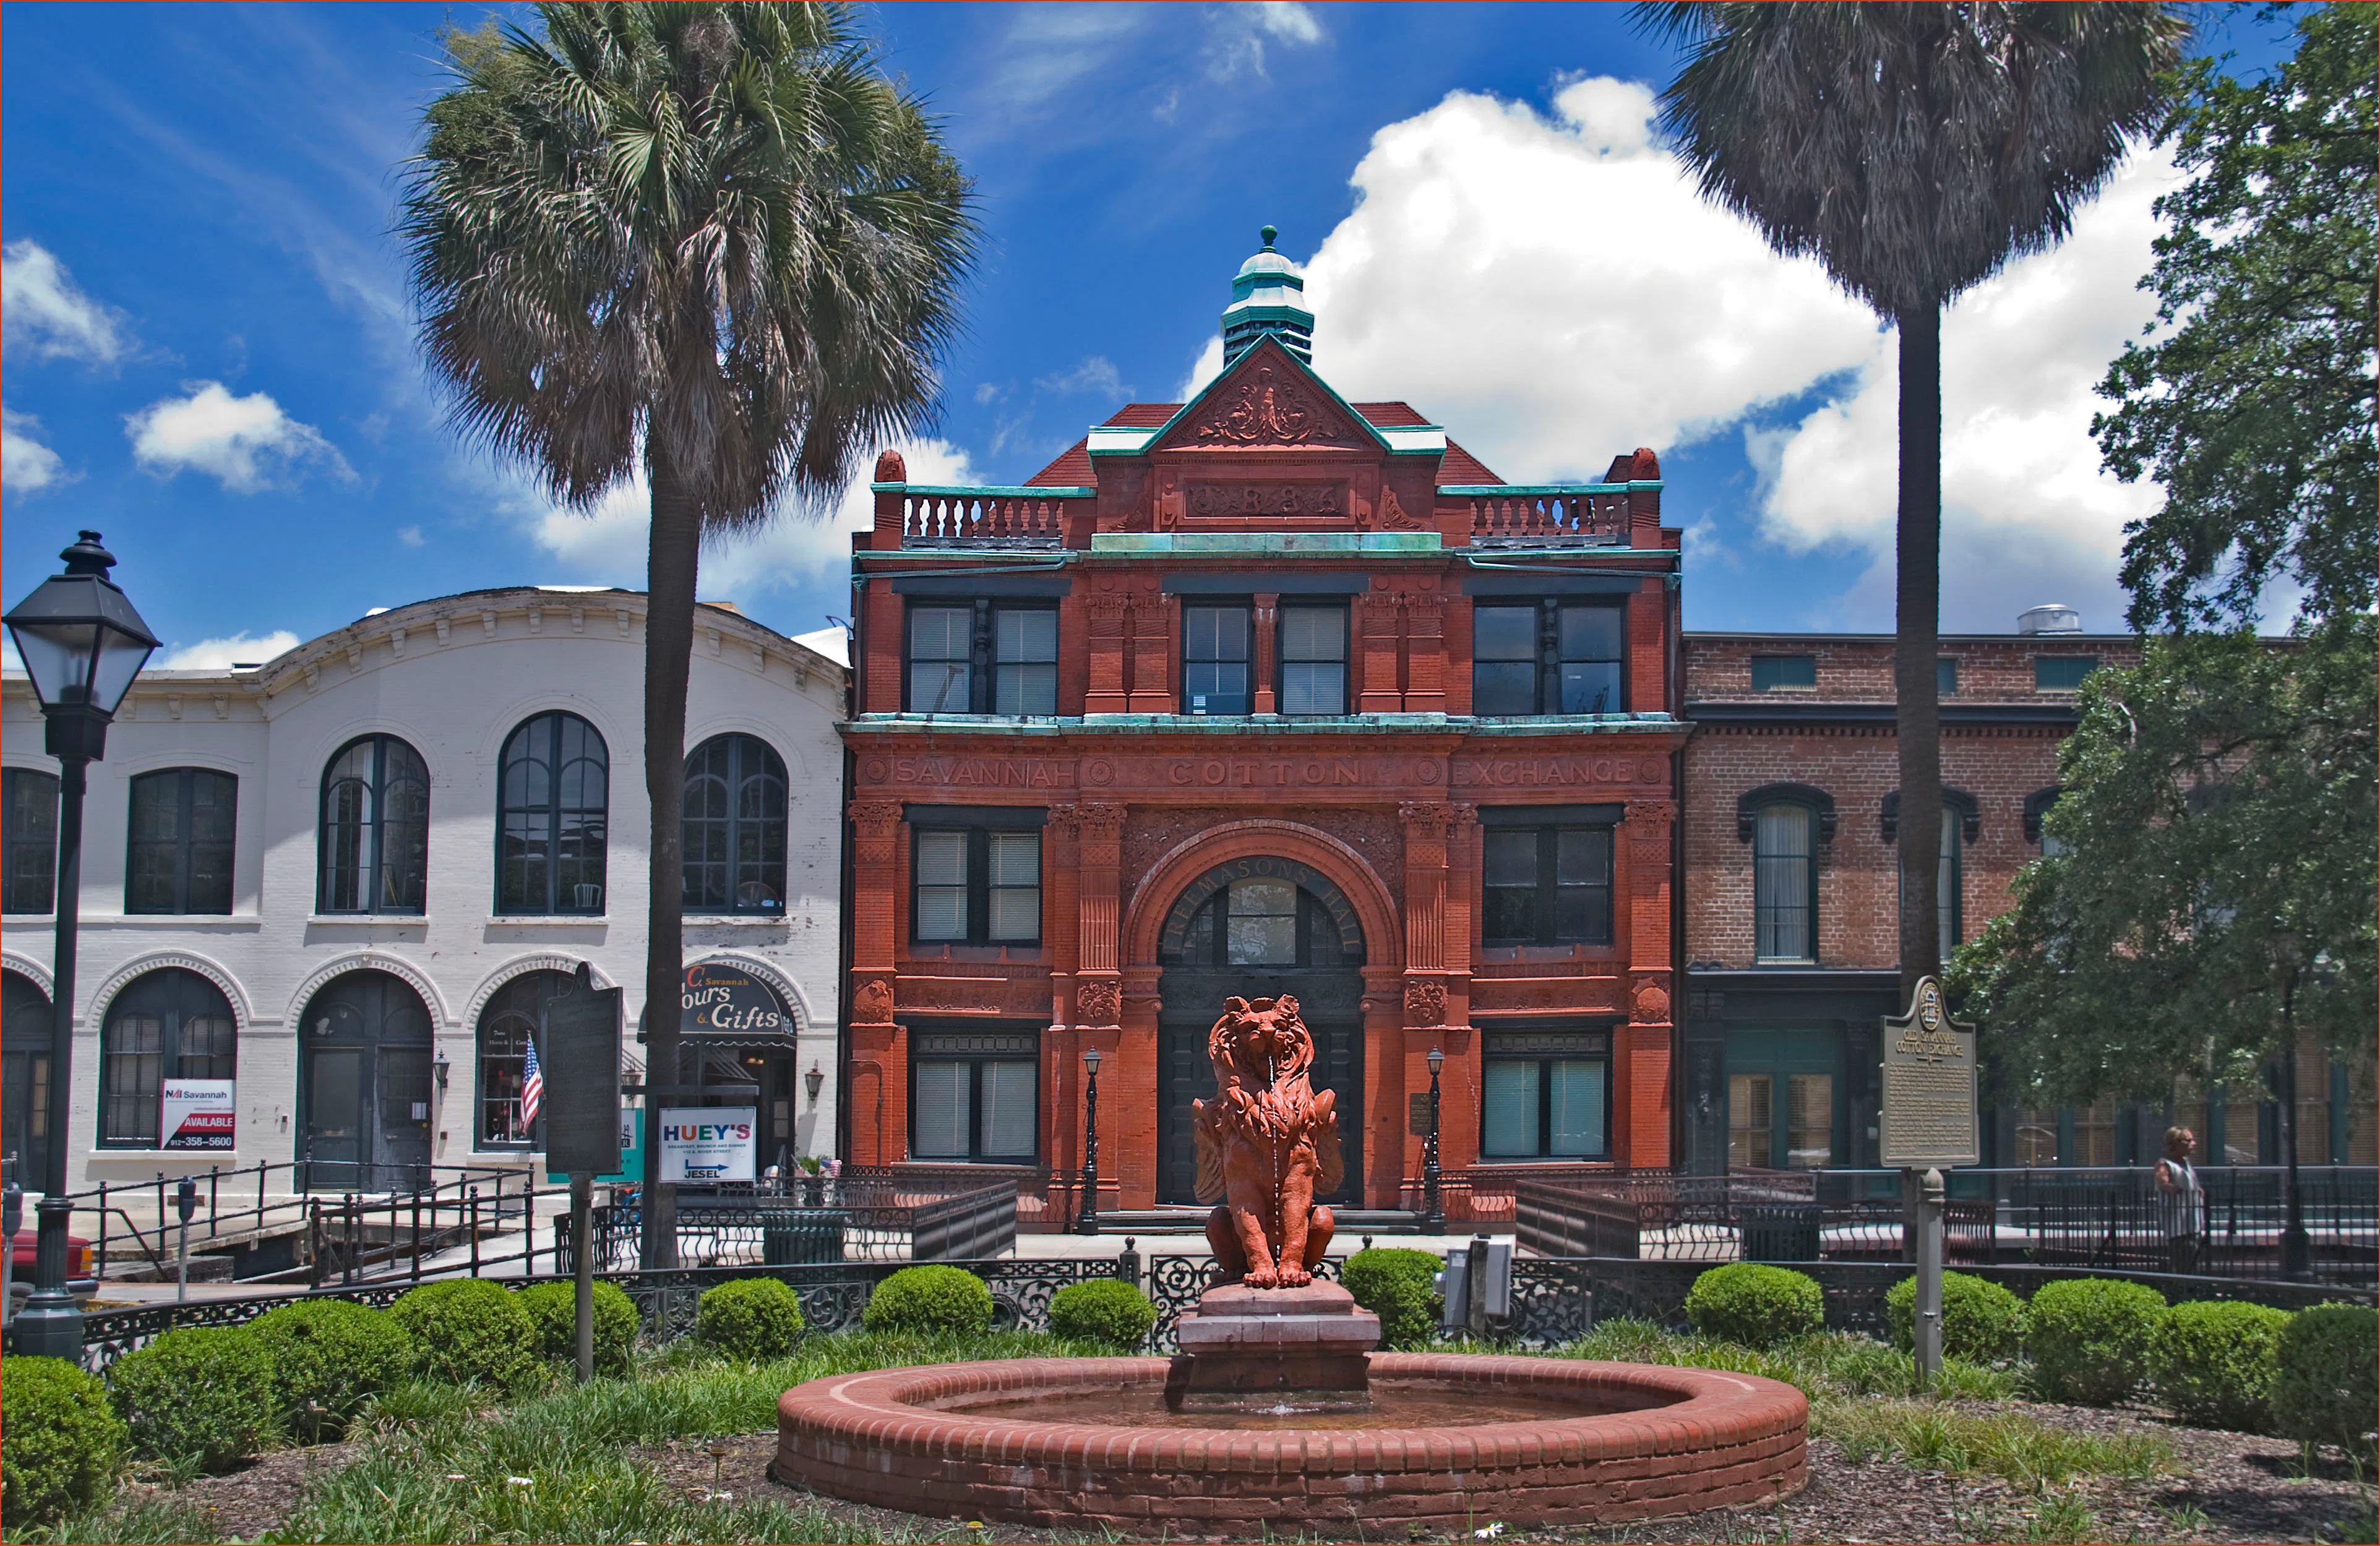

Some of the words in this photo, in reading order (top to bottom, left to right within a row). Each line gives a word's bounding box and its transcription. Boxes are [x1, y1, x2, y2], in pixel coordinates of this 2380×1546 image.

[895, 759, 1079, 787] SAVANNAH
[1169, 760, 1359, 785] COTTON
[1451, 759, 1634, 786] EXCHANGE
[1323, 887, 1360, 951] HALL
[705, 977, 749, 986] Savannah
[682, 982, 731, 1010] ours
[697, 1012, 708, 1024] &
[711, 1003, 780, 1030] Gifts
[1904, 1029, 1918, 1041] OLD
[1921, 1031, 1956, 1044] SAVANNAH
[1896, 1041, 1925, 1053] COTTON
[1928, 1044, 1964, 1056] EXCHANGE
[166, 1089, 183, 1098] NAI
[184, 1091, 227, 1099] Savannah
[185, 1117, 233, 1127] AVAILABLE
[664, 1124, 750, 1141] HUEY'S
[170, 1136, 232, 1146] 912-358-5600
[684, 1170, 720, 1179] JESEL
